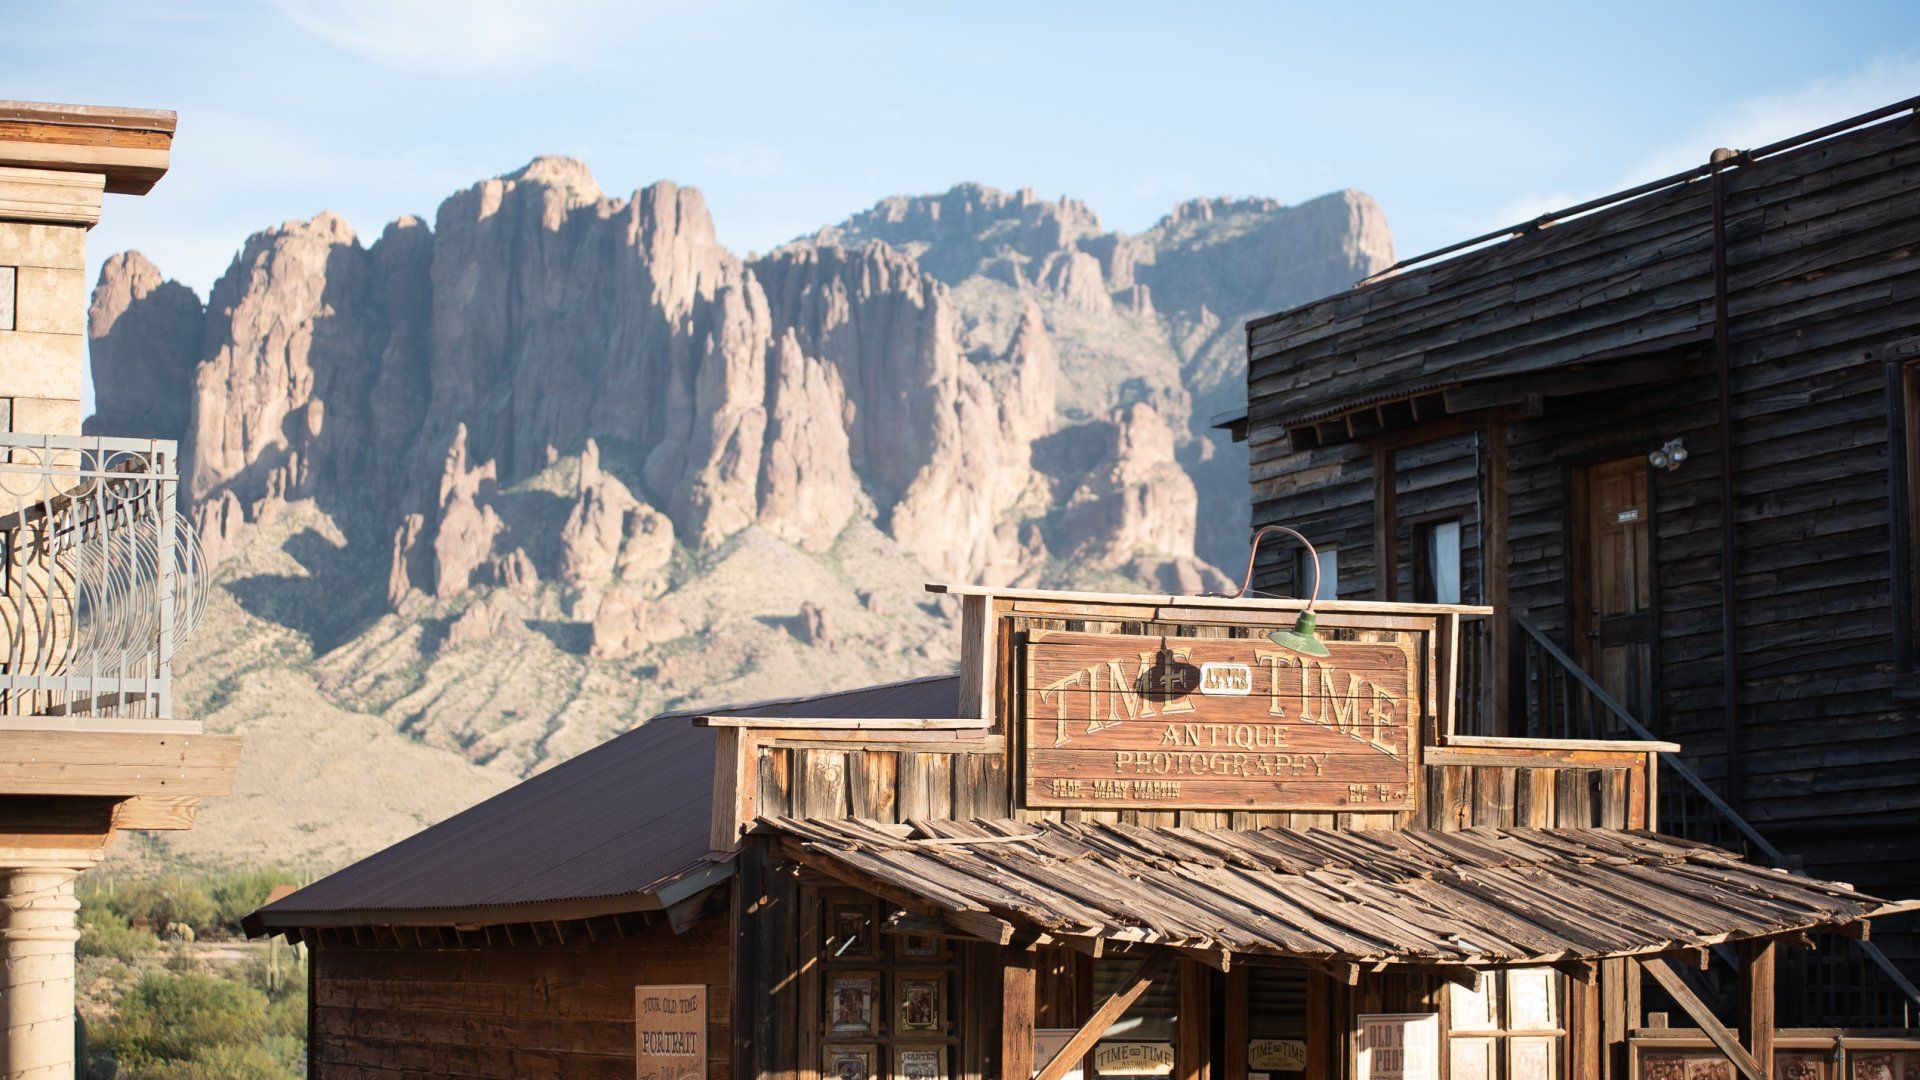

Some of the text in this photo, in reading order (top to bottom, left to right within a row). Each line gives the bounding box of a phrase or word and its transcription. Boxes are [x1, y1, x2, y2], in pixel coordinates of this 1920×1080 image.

[1039, 648, 1401, 761] TIME AFTER TIME
[1159, 723, 1290, 751] ANTIQUE
[1115, 751, 1331, 777] PHOTOGRAPHY
[663, 998, 676, 1013] OLD
[680, 995, 697, 1013] TIME
[642, 1031, 697, 1056] PORTRAIT
[1370, 1025, 1391, 1047] OLD
[1098, 1046, 1171, 1066] TIME TIME
[1250, 1042, 1304, 1064] TIME TIME
